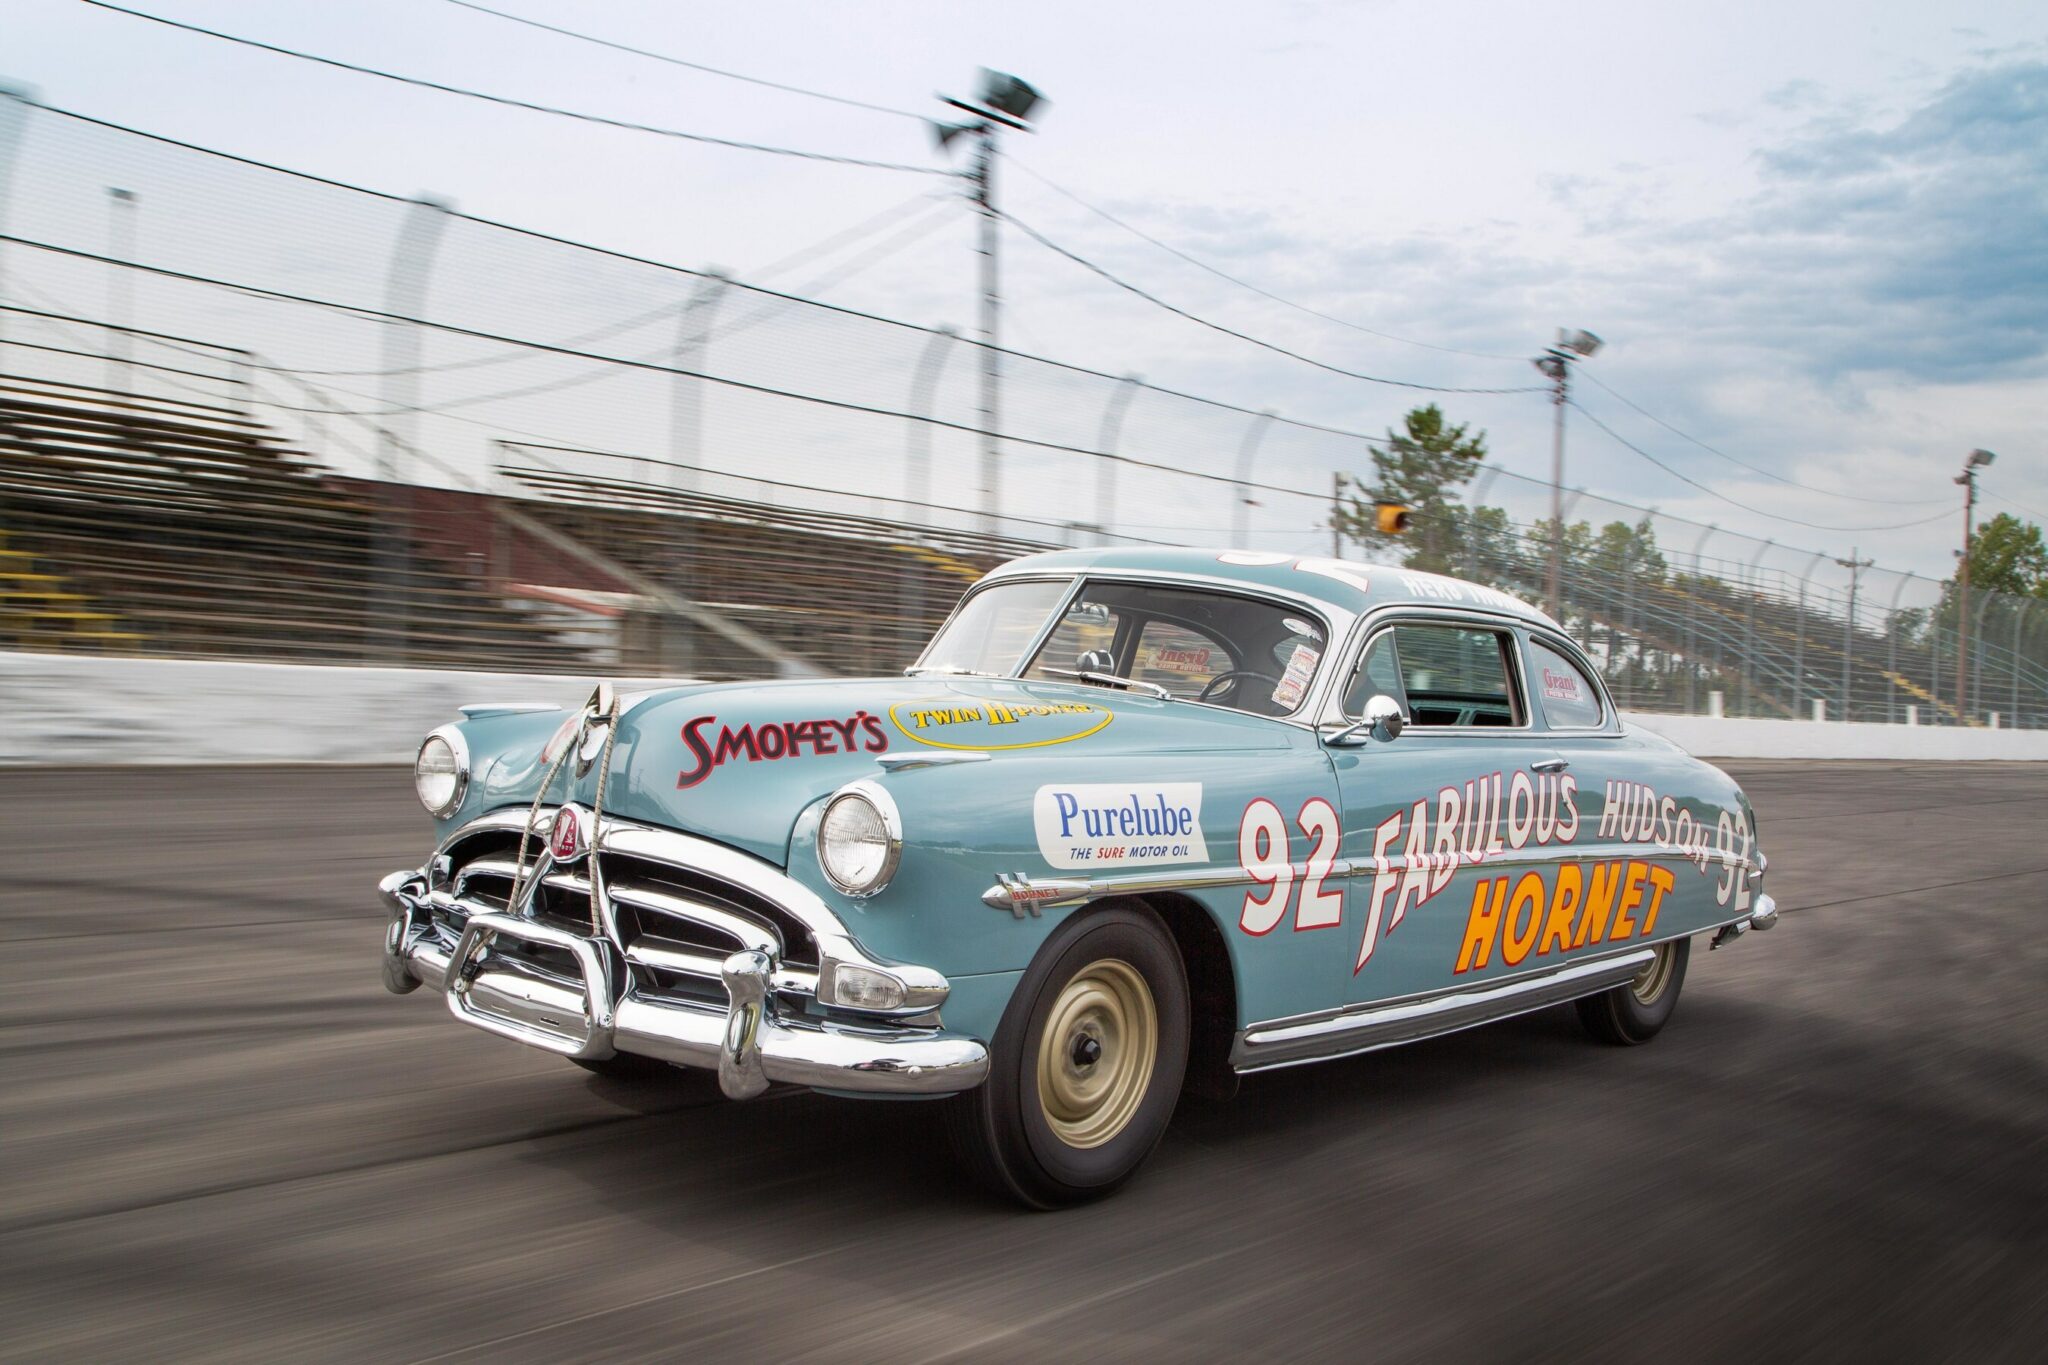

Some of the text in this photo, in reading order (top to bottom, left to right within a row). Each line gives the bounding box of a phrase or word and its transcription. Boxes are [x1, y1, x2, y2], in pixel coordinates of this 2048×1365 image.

[1543, 667, 1577, 691] Grant
[909, 707, 982, 728] TWIN
[676, 711, 888, 789] SMOKEY'S
[1052, 793, 1193, 838] Purelube
[1070, 845, 1189, 860] THE SURE MOTOR OIL
[1238, 796, 1344, 937] 92
[1353, 770, 1710, 977] FABULOUS HUDSON
[1715, 809, 1753, 912] 92
[1011, 887, 1061, 901] HORNET
[1453, 860, 1675, 975] HORNET
